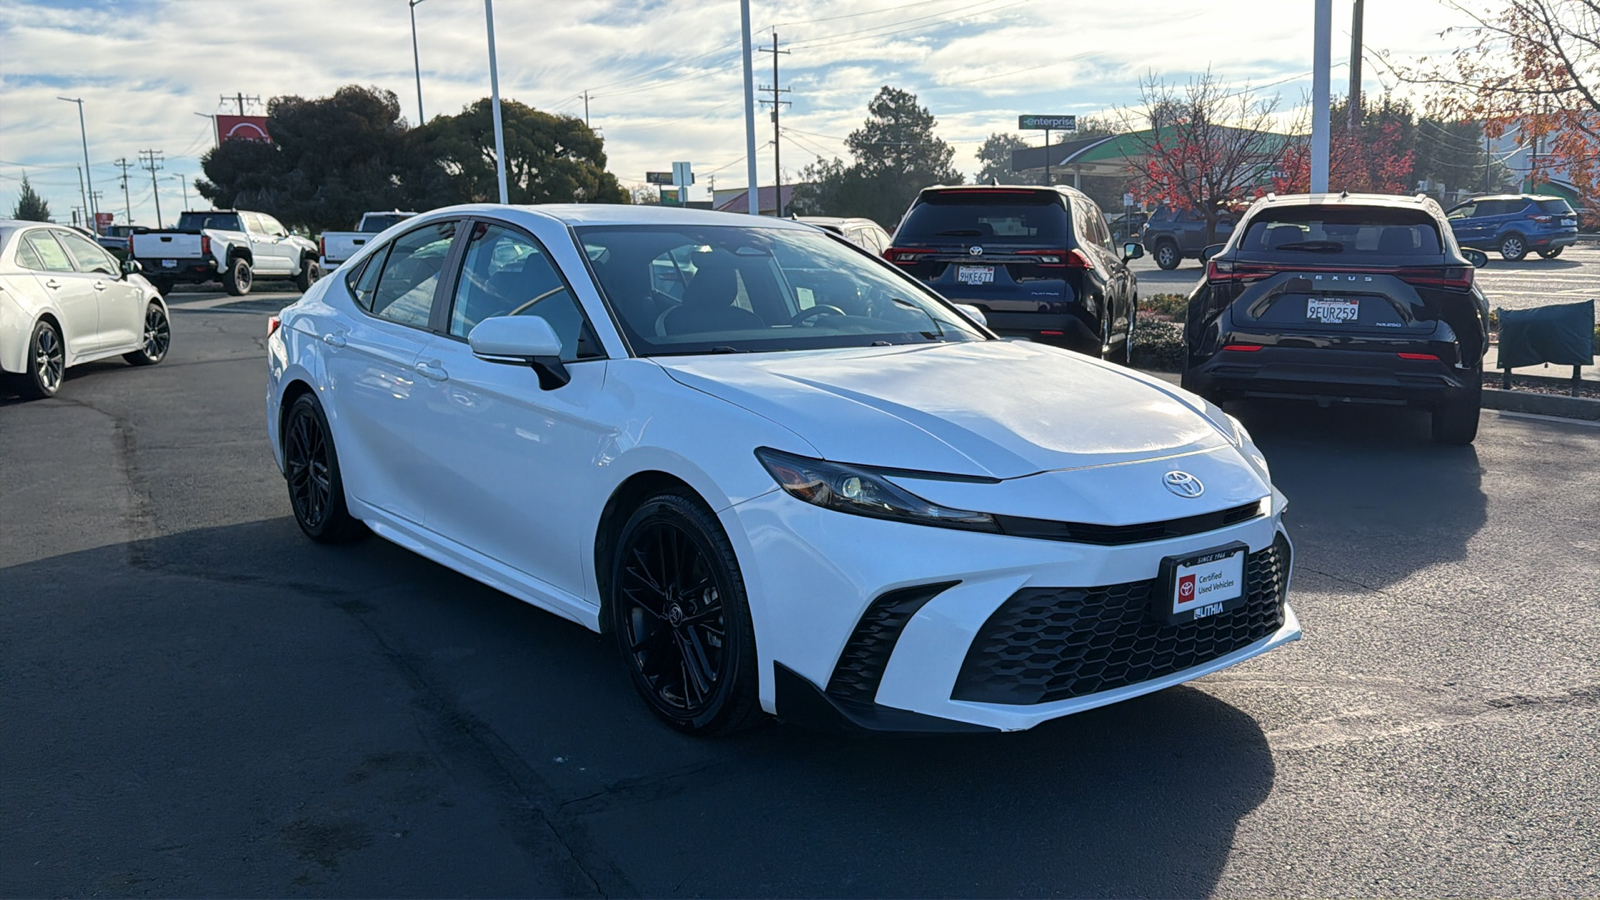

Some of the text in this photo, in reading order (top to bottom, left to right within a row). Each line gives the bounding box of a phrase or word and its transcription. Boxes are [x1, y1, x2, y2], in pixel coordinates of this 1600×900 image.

[1024, 117, 1075, 128] enterprise
[959, 272, 993, 282] 9HKE677
[1309, 306, 1356, 320] 9EUR259
[1197, 554, 1213, 563] SINCE
[1199, 571, 1222, 583] Certified
[1199, 580, 1234, 594] Used Vehicles
[1201, 602, 1223, 617] LITHIA
